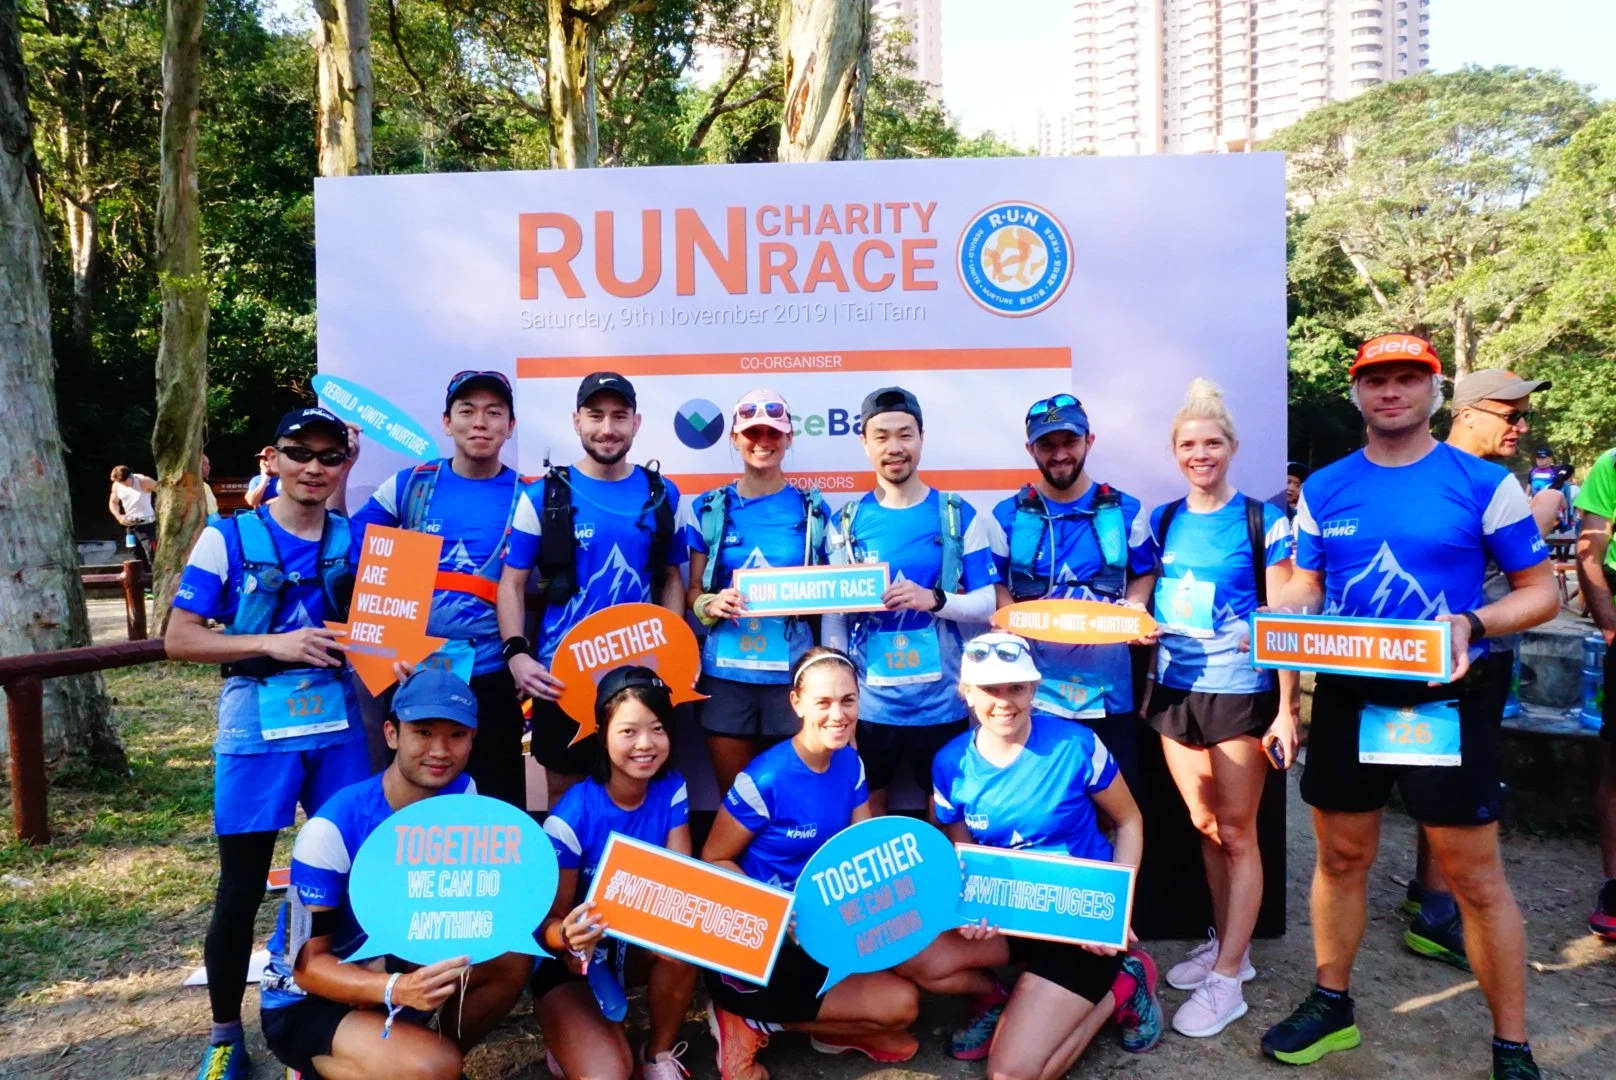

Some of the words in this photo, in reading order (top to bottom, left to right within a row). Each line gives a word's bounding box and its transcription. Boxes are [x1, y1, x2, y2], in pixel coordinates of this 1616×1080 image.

[755, 201, 938, 237] CHARITY
[519, 206, 747, 300] RUN
[759, 238, 938, 294] RACE
[519, 305, 616, 333] Saturday,
[619, 307, 654, 327] 9th
[660, 303, 768, 327] November
[774, 302, 827, 324] 2019
[842, 301, 873, 323] Tai
[878, 301, 926, 322] Tam
[740, 355, 842, 371] CO-ORGANISER
[1365, 339, 1422, 359] ciele
[321, 381, 359, 412] REBUILD
[1322, 523, 1357, 539] KPMG
[369, 535, 394, 558] YOU
[361, 564, 388, 586] ARE
[749, 582, 777, 602] RUN
[780, 579, 837, 601] CHARITY
[840, 578, 877, 598] RACE
[357, 592, 420, 620] WELCOME
[1009, 610, 1049, 630] REBUILD
[350, 621, 385, 644] HERE
[569, 617, 668, 672] TOGETHER
[739, 635, 767, 653] 80
[1265, 630, 1298, 653] RUN
[1303, 633, 1375, 660] CHARITY
[1379, 637, 1428, 663] RACE
[884, 649, 921, 669] 128
[286, 695, 324, 717] 122
[1385, 721, 1432, 744] 126
[394, 825, 522, 866] TOGETHER
[786, 828, 817, 840] KPMG
[407, 870, 435, 899] WE
[438, 869, 473, 898] CAN
[476, 869, 501, 898] DO
[811, 832, 924, 907] TOGETHER
[604, 869, 768, 950] #WITHREFUGEES
[838, 897, 865, 927] WE
[864, 883, 895, 915] CAN
[893, 874, 916, 902] DO
[963, 874, 1116, 921] #WITHREFUGEES
[407, 910, 493, 941] ANYTHING
[856, 908, 923, 958] ANYTHING
